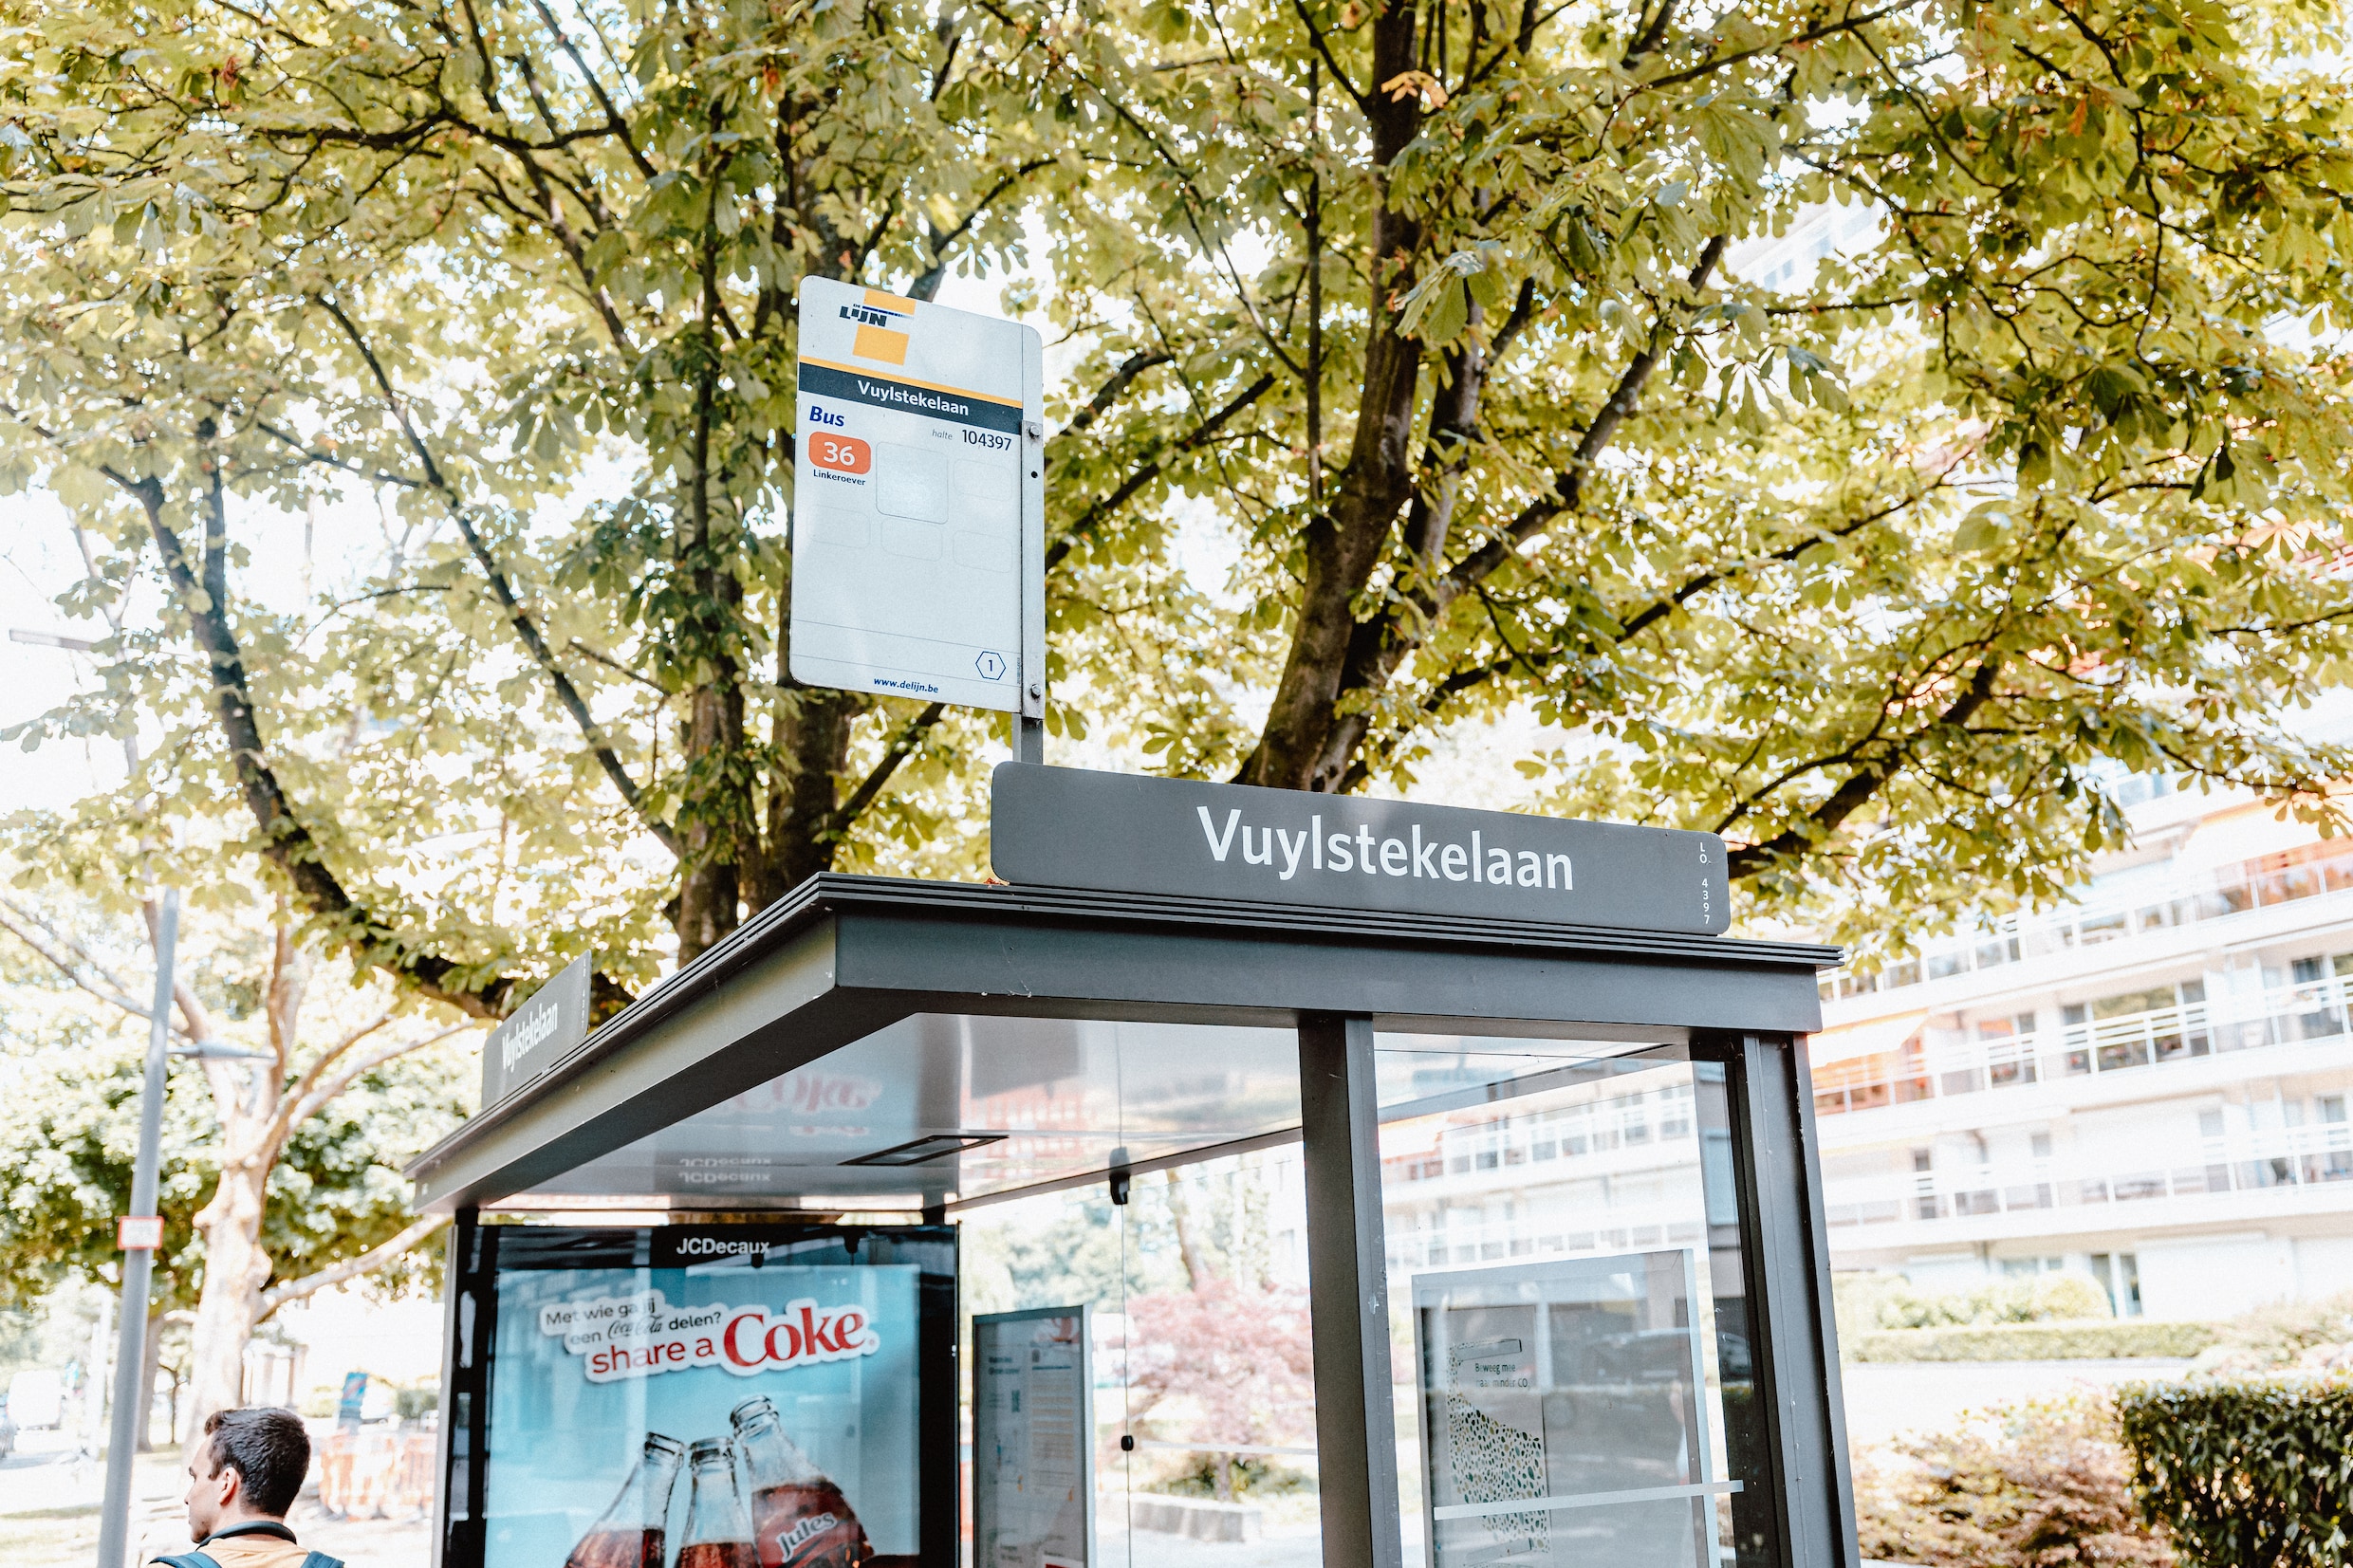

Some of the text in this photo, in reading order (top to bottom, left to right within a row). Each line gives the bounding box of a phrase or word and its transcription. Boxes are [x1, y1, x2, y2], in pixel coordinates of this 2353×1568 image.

[858, 379, 969, 415] Vuylstekelaan
[809, 406, 844, 427] Bus
[932, 429, 1011, 451] halte 104397
[823, 441, 856, 466] 36
[813, 469, 865, 486] Linkeroever
[989, 659, 993, 672] 1
[874, 677, 938, 693] www.delijn.be
[1196, 805, 1573, 890] Vuylstekelaan
[1701, 878, 1710, 924] 4397
[502, 1003, 558, 1073] Vuylstekelaan
[676, 1237, 769, 1255] JCDecaux
[546, 1311, 580, 1325] Met
[584, 1304, 613, 1319] wie
[570, 1331, 602, 1345] een
[669, 1311, 721, 1331] delen?
[592, 1306, 865, 1374] share a Coke
[1474, 1363, 1500, 1374] Beweeg
[780, 1513, 835, 1559] Jules
